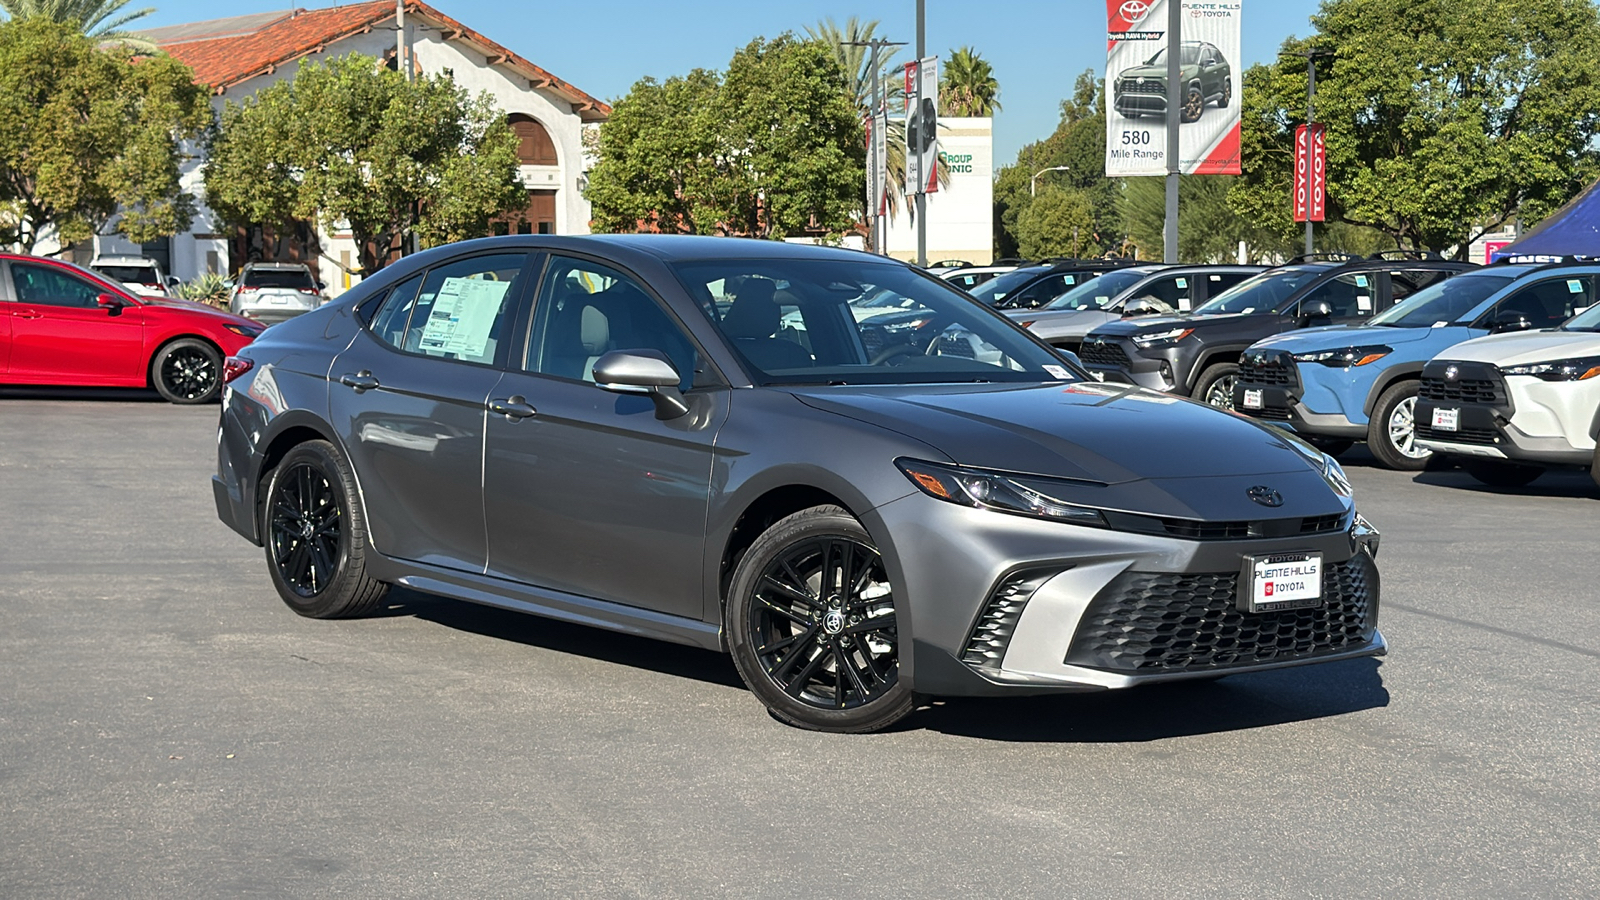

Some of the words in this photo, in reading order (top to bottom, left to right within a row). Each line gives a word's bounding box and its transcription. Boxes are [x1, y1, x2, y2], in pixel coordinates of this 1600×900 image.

[1125, 32, 1141, 40] RAV4
[1141, 32, 1160, 40] Hybrid
[1121, 130, 1150, 145] 580
[1110, 149, 1131, 159] Mile
[1133, 149, 1164, 161] Range
[1298, 130, 1306, 216] TOYOTA
[1314, 130, 1322, 216] TOYOTA
[1269, 554, 1306, 562] TOYOTA
[1255, 567, 1290, 579] PUENTE
[1290, 565, 1316, 576] HILLS
[1275, 582, 1305, 592] TOYOTA
[1256, 601, 1291, 611] PUENTE
